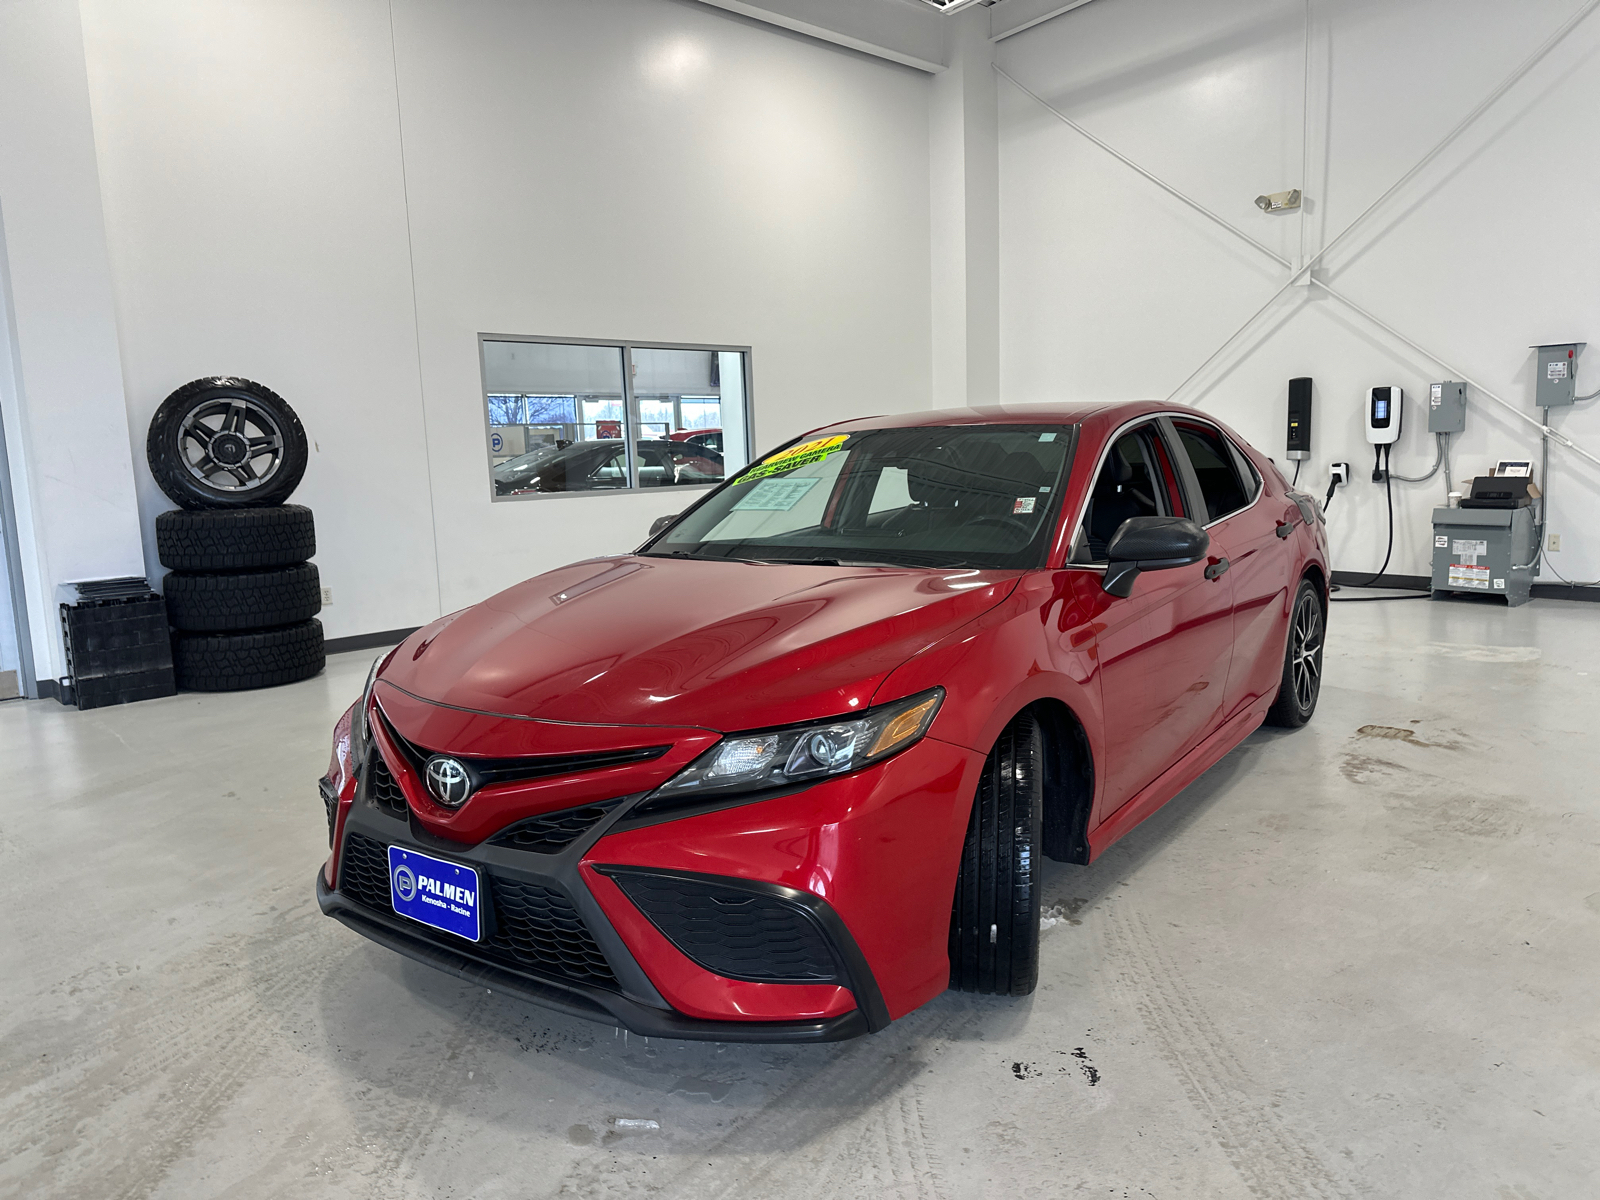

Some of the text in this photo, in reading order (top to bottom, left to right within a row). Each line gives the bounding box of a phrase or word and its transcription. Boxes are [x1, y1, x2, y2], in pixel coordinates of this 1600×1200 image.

[749, 444, 840, 474] REARVIEW CAMERA
[775, 437, 835, 460] 2021
[737, 454, 822, 483] GAS-SAVER
[417, 875, 475, 907] PALMEN
[421, 894, 447, 908] Kenosha
[451, 903, 471, 918] Racine
